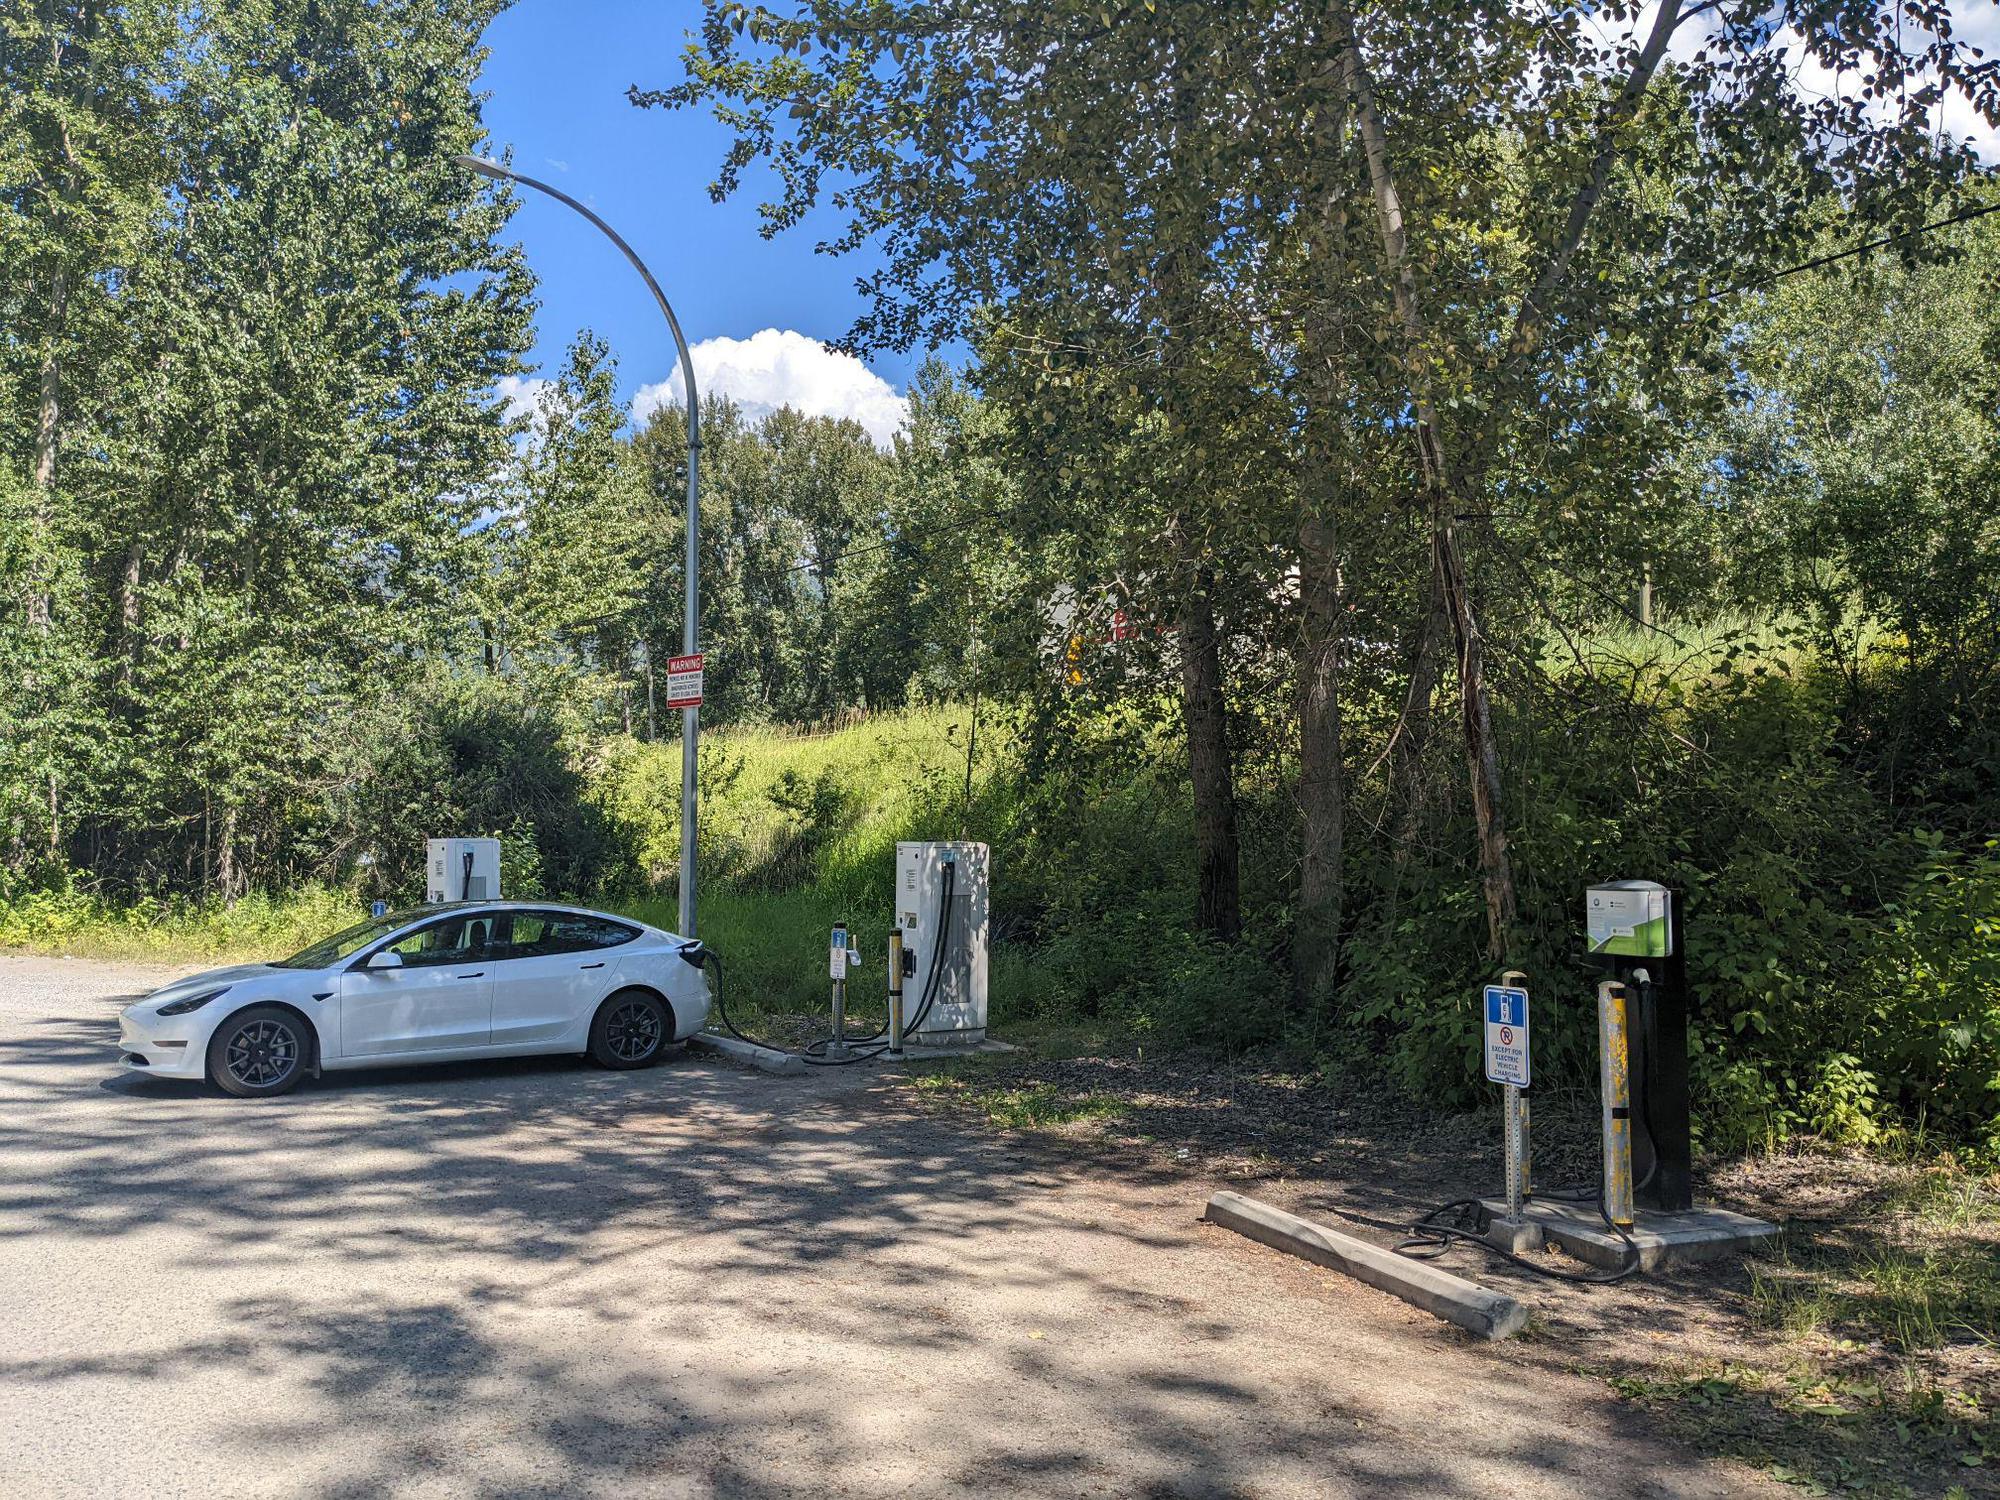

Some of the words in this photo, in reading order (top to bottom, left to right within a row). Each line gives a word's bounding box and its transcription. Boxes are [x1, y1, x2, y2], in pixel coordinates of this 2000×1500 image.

[671, 658, 701, 671] WARNING
[1492, 1045, 1511, 1054] EXCEPT
[1496, 1054, 1519, 1063] ELECTRIC
[1497, 1062, 1518, 1070] VEHICLE
[1495, 1069, 1520, 1079] CHARGING
